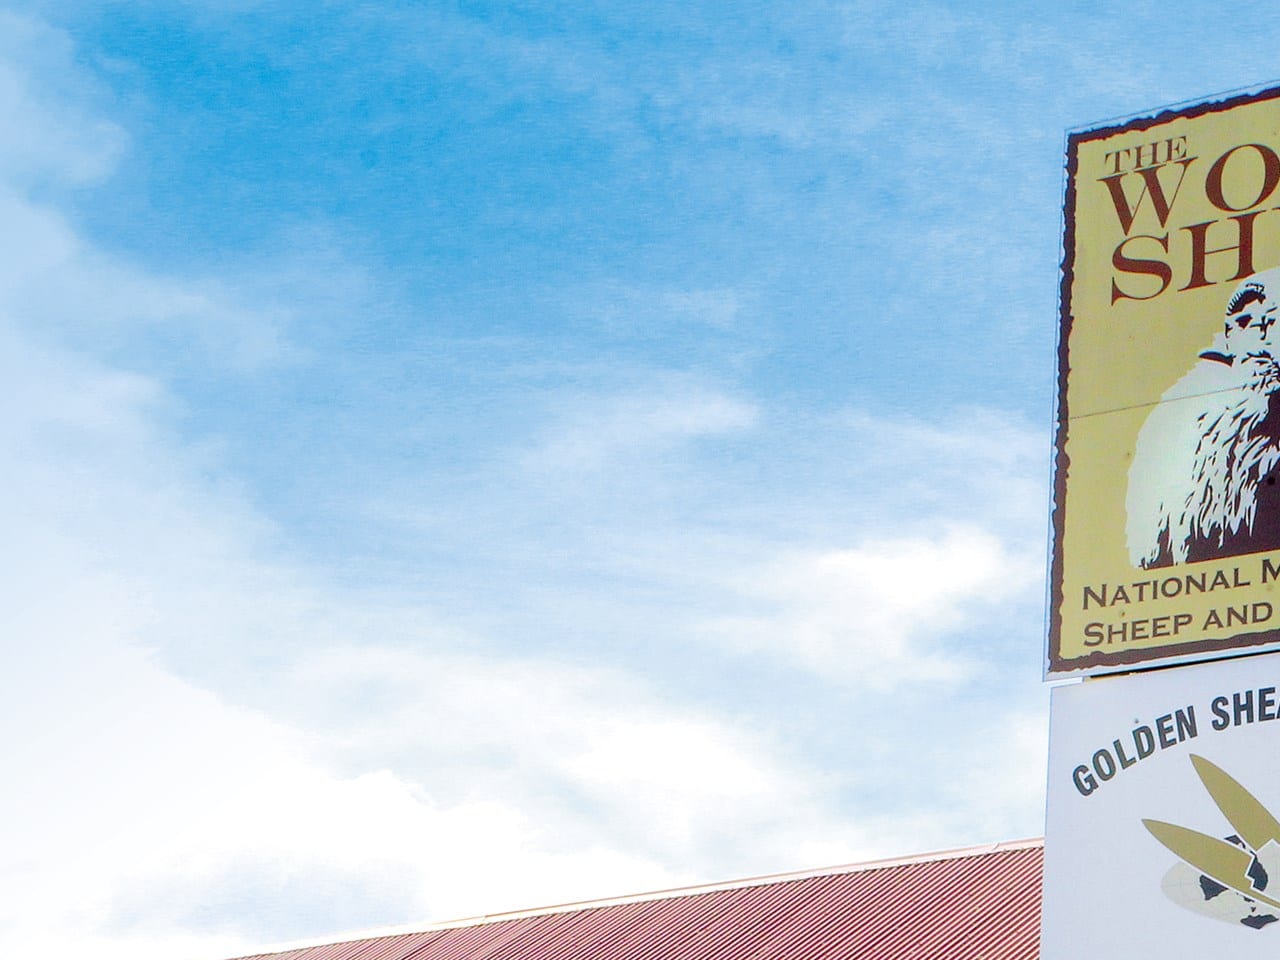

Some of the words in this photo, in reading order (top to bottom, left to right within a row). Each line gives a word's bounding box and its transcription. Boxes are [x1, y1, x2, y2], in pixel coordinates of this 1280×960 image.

[1105, 135, 1188, 174] THE
[1082, 566, 1251, 610] NATIONAL
[1082, 614, 1193, 647] SHEEP
[1202, 602, 1274, 631] AND
[1072, 705, 1198, 797] GOLDEN
